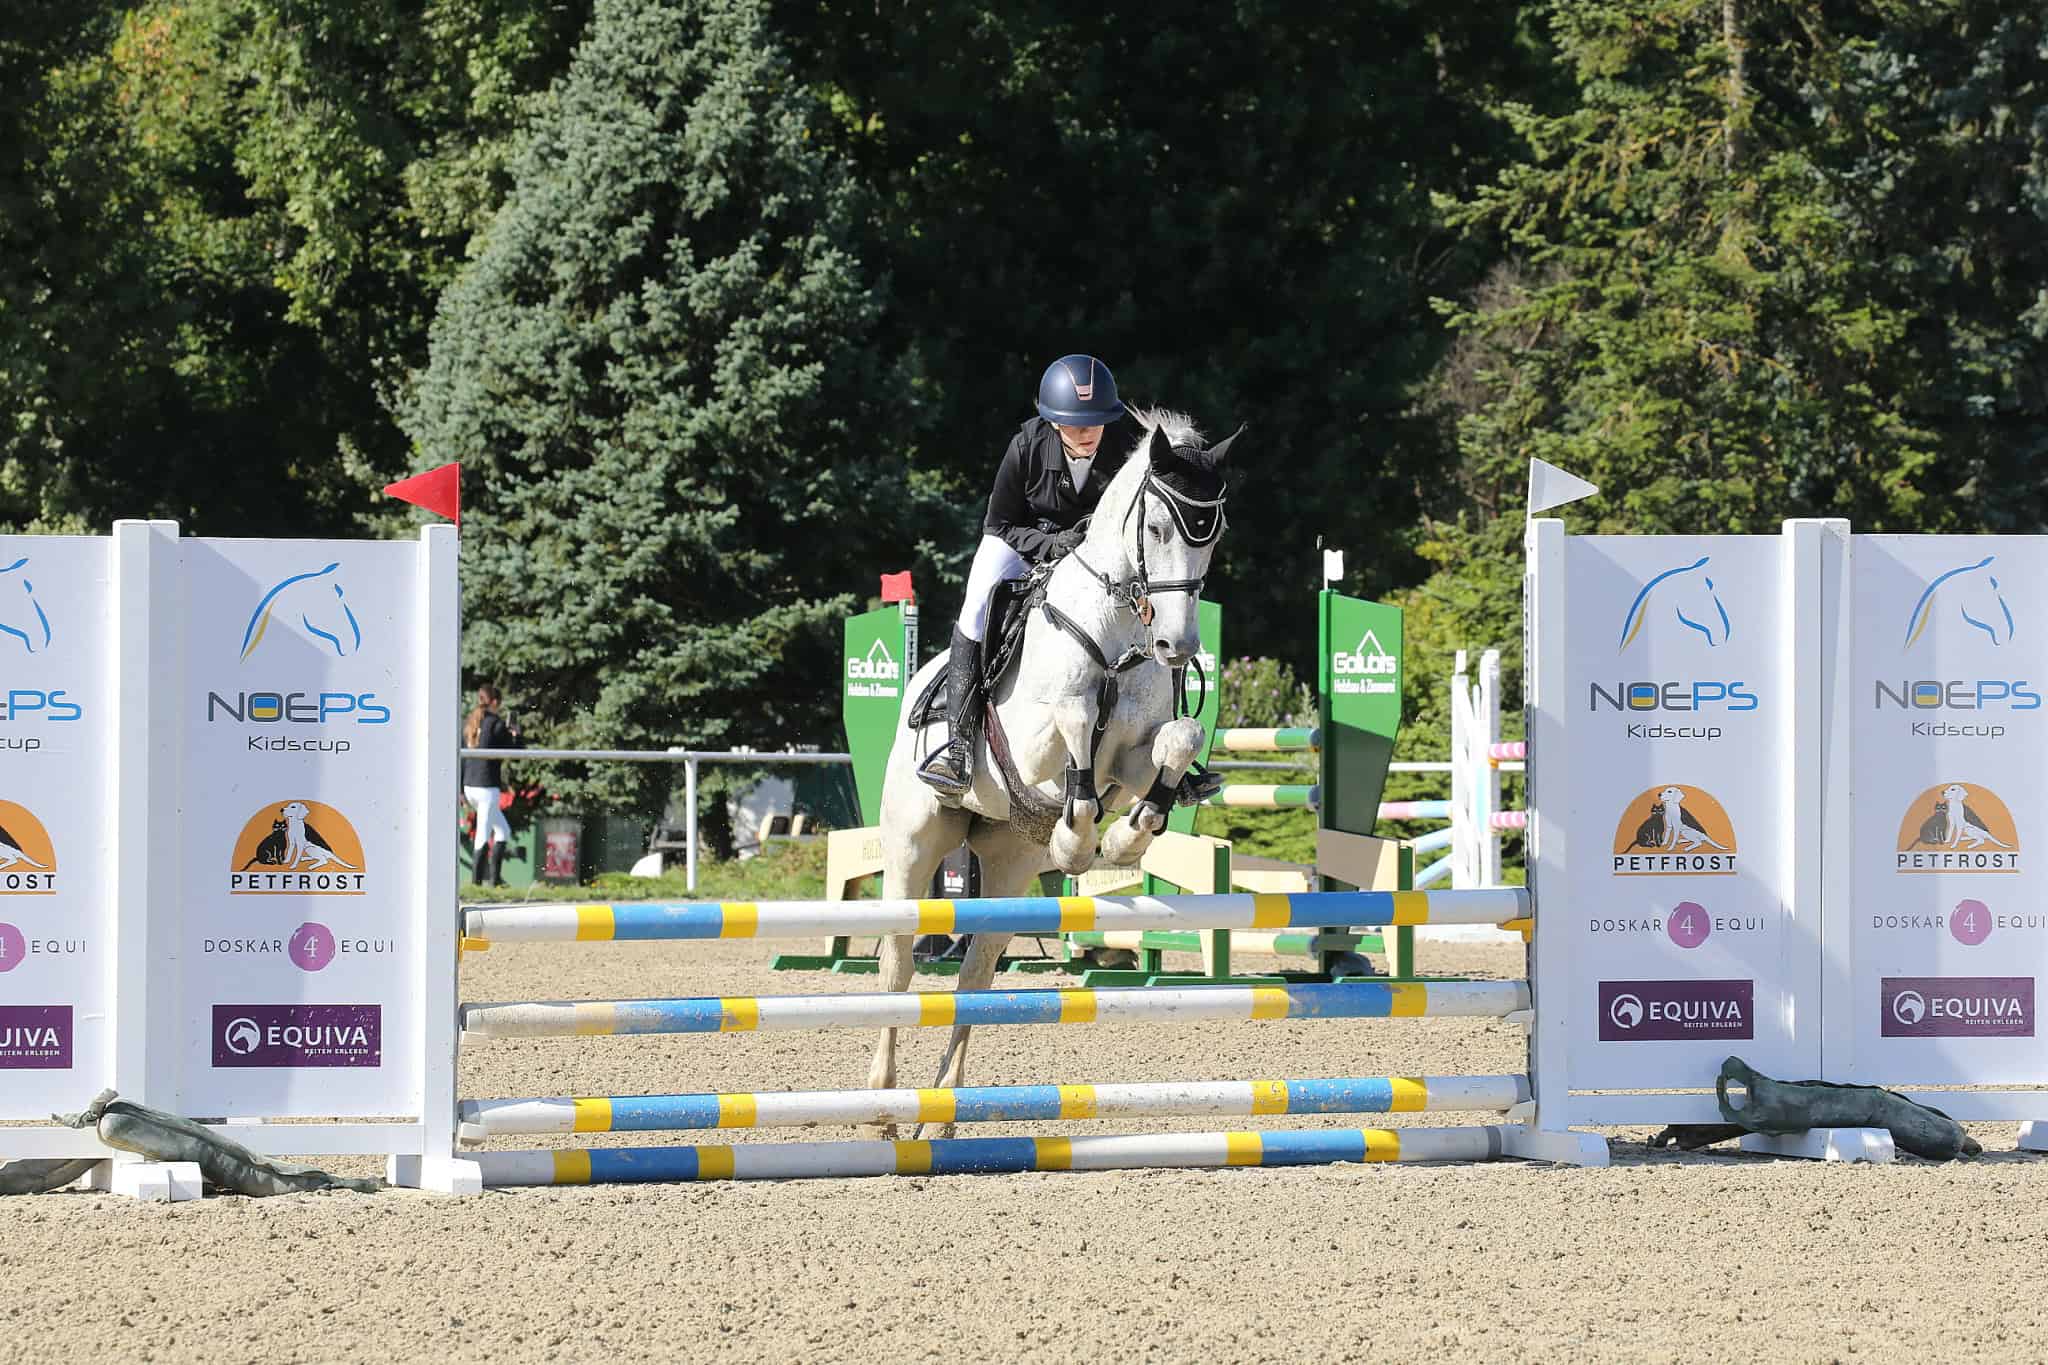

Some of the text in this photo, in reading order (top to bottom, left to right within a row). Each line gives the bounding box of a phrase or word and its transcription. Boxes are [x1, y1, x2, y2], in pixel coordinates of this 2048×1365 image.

[1590, 681, 1759, 712] NOEPS
[1875, 679, 2043, 711] NOEPS
[208, 691, 391, 724] NOEPS
[1626, 721, 1722, 740] Kidscup
[1911, 720, 2006, 739] Kidscup
[248, 735, 351, 755] Kidscup
[1613, 854, 1737, 871] PETFROST
[1896, 852, 2019, 869] PETFROST
[231, 874, 365, 890] PETFROST
[1590, 913, 1765, 936] DOSKAR 4 EQUI
[1873, 911, 2046, 934] DOSKAR 4 EQUI
[31, 939, 86, 954] EQUI
[204, 935, 394, 959] DOSKAR 4 EQUI
[1649, 1000, 1742, 1022] EQUIVA
[1931, 998, 2023, 1019] EQUIVA
[267, 1026, 368, 1048] EQUIVA
